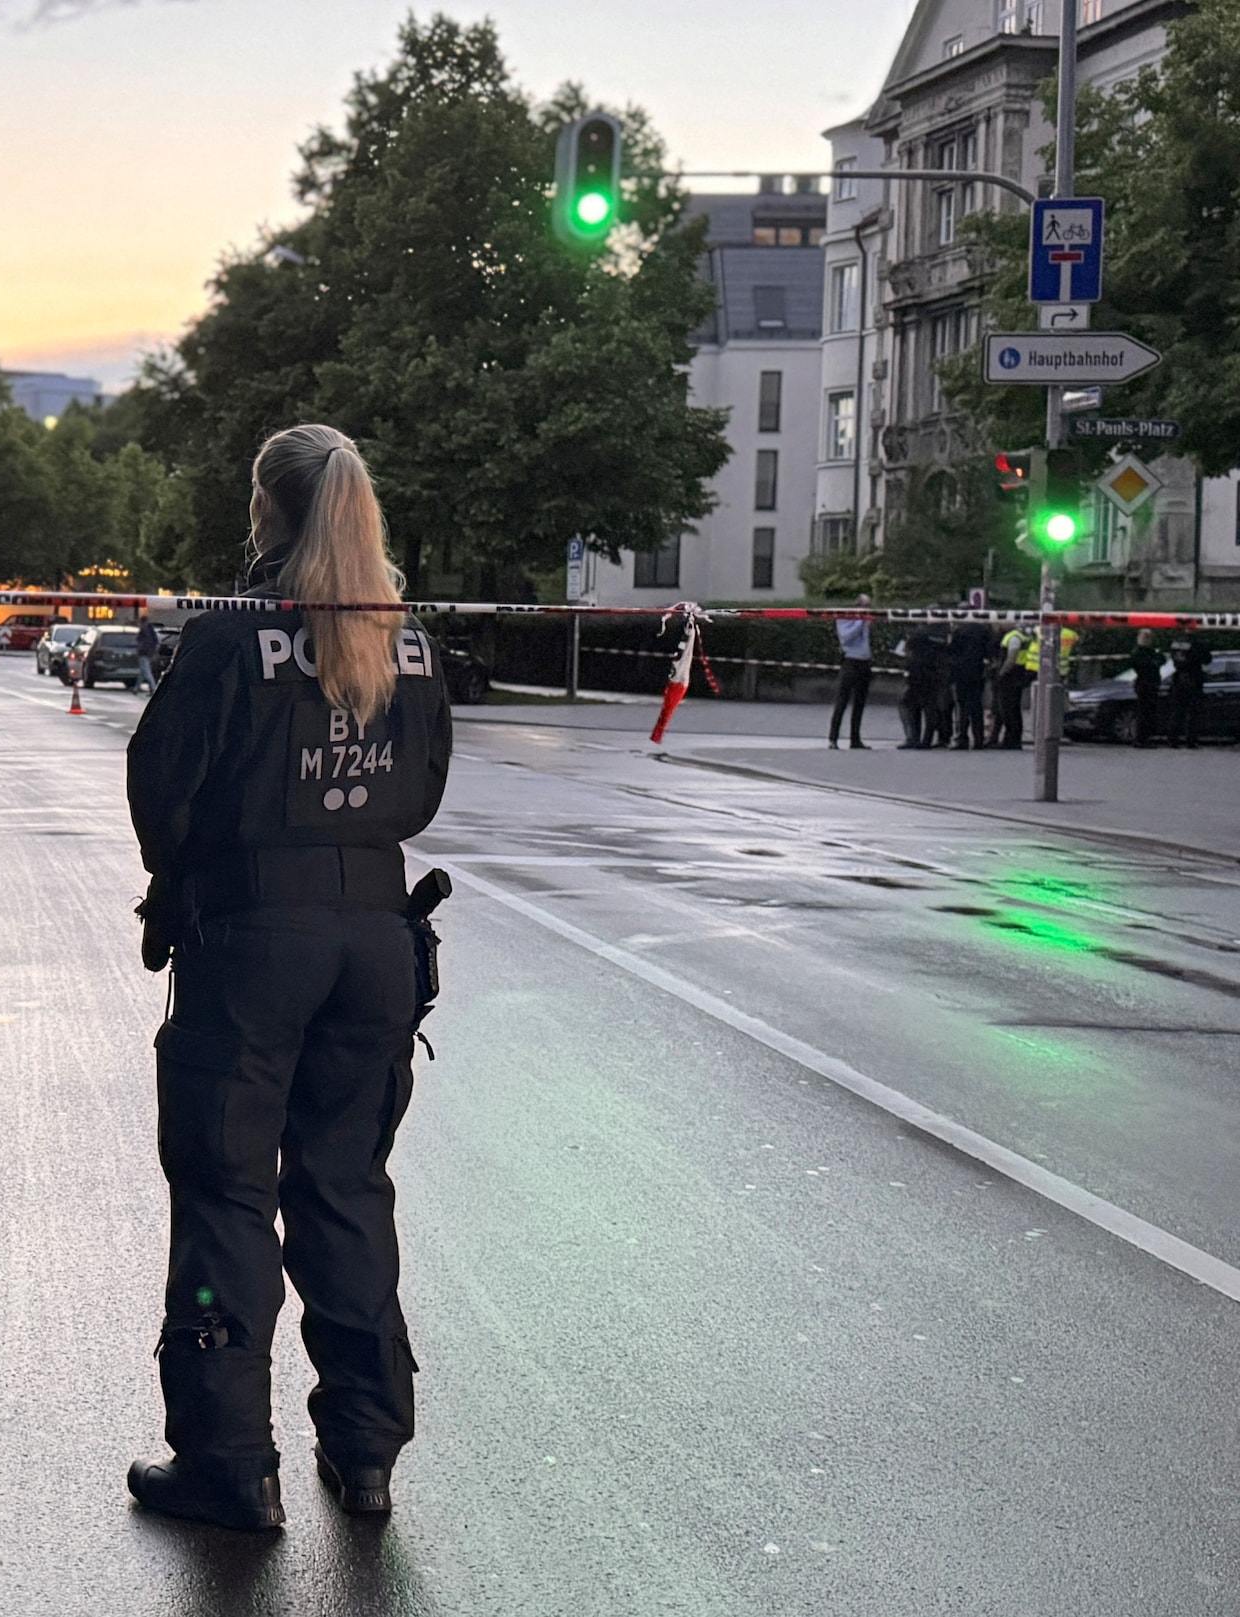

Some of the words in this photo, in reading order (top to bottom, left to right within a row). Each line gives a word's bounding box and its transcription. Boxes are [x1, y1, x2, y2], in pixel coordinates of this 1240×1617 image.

[1028, 351, 1124, 369] Hauptbahnhof
[258, 628, 433, 680] POEI
[329, 708, 369, 742] BY
[300, 748, 322, 780] M
[331, 740, 393, 778] 7244
